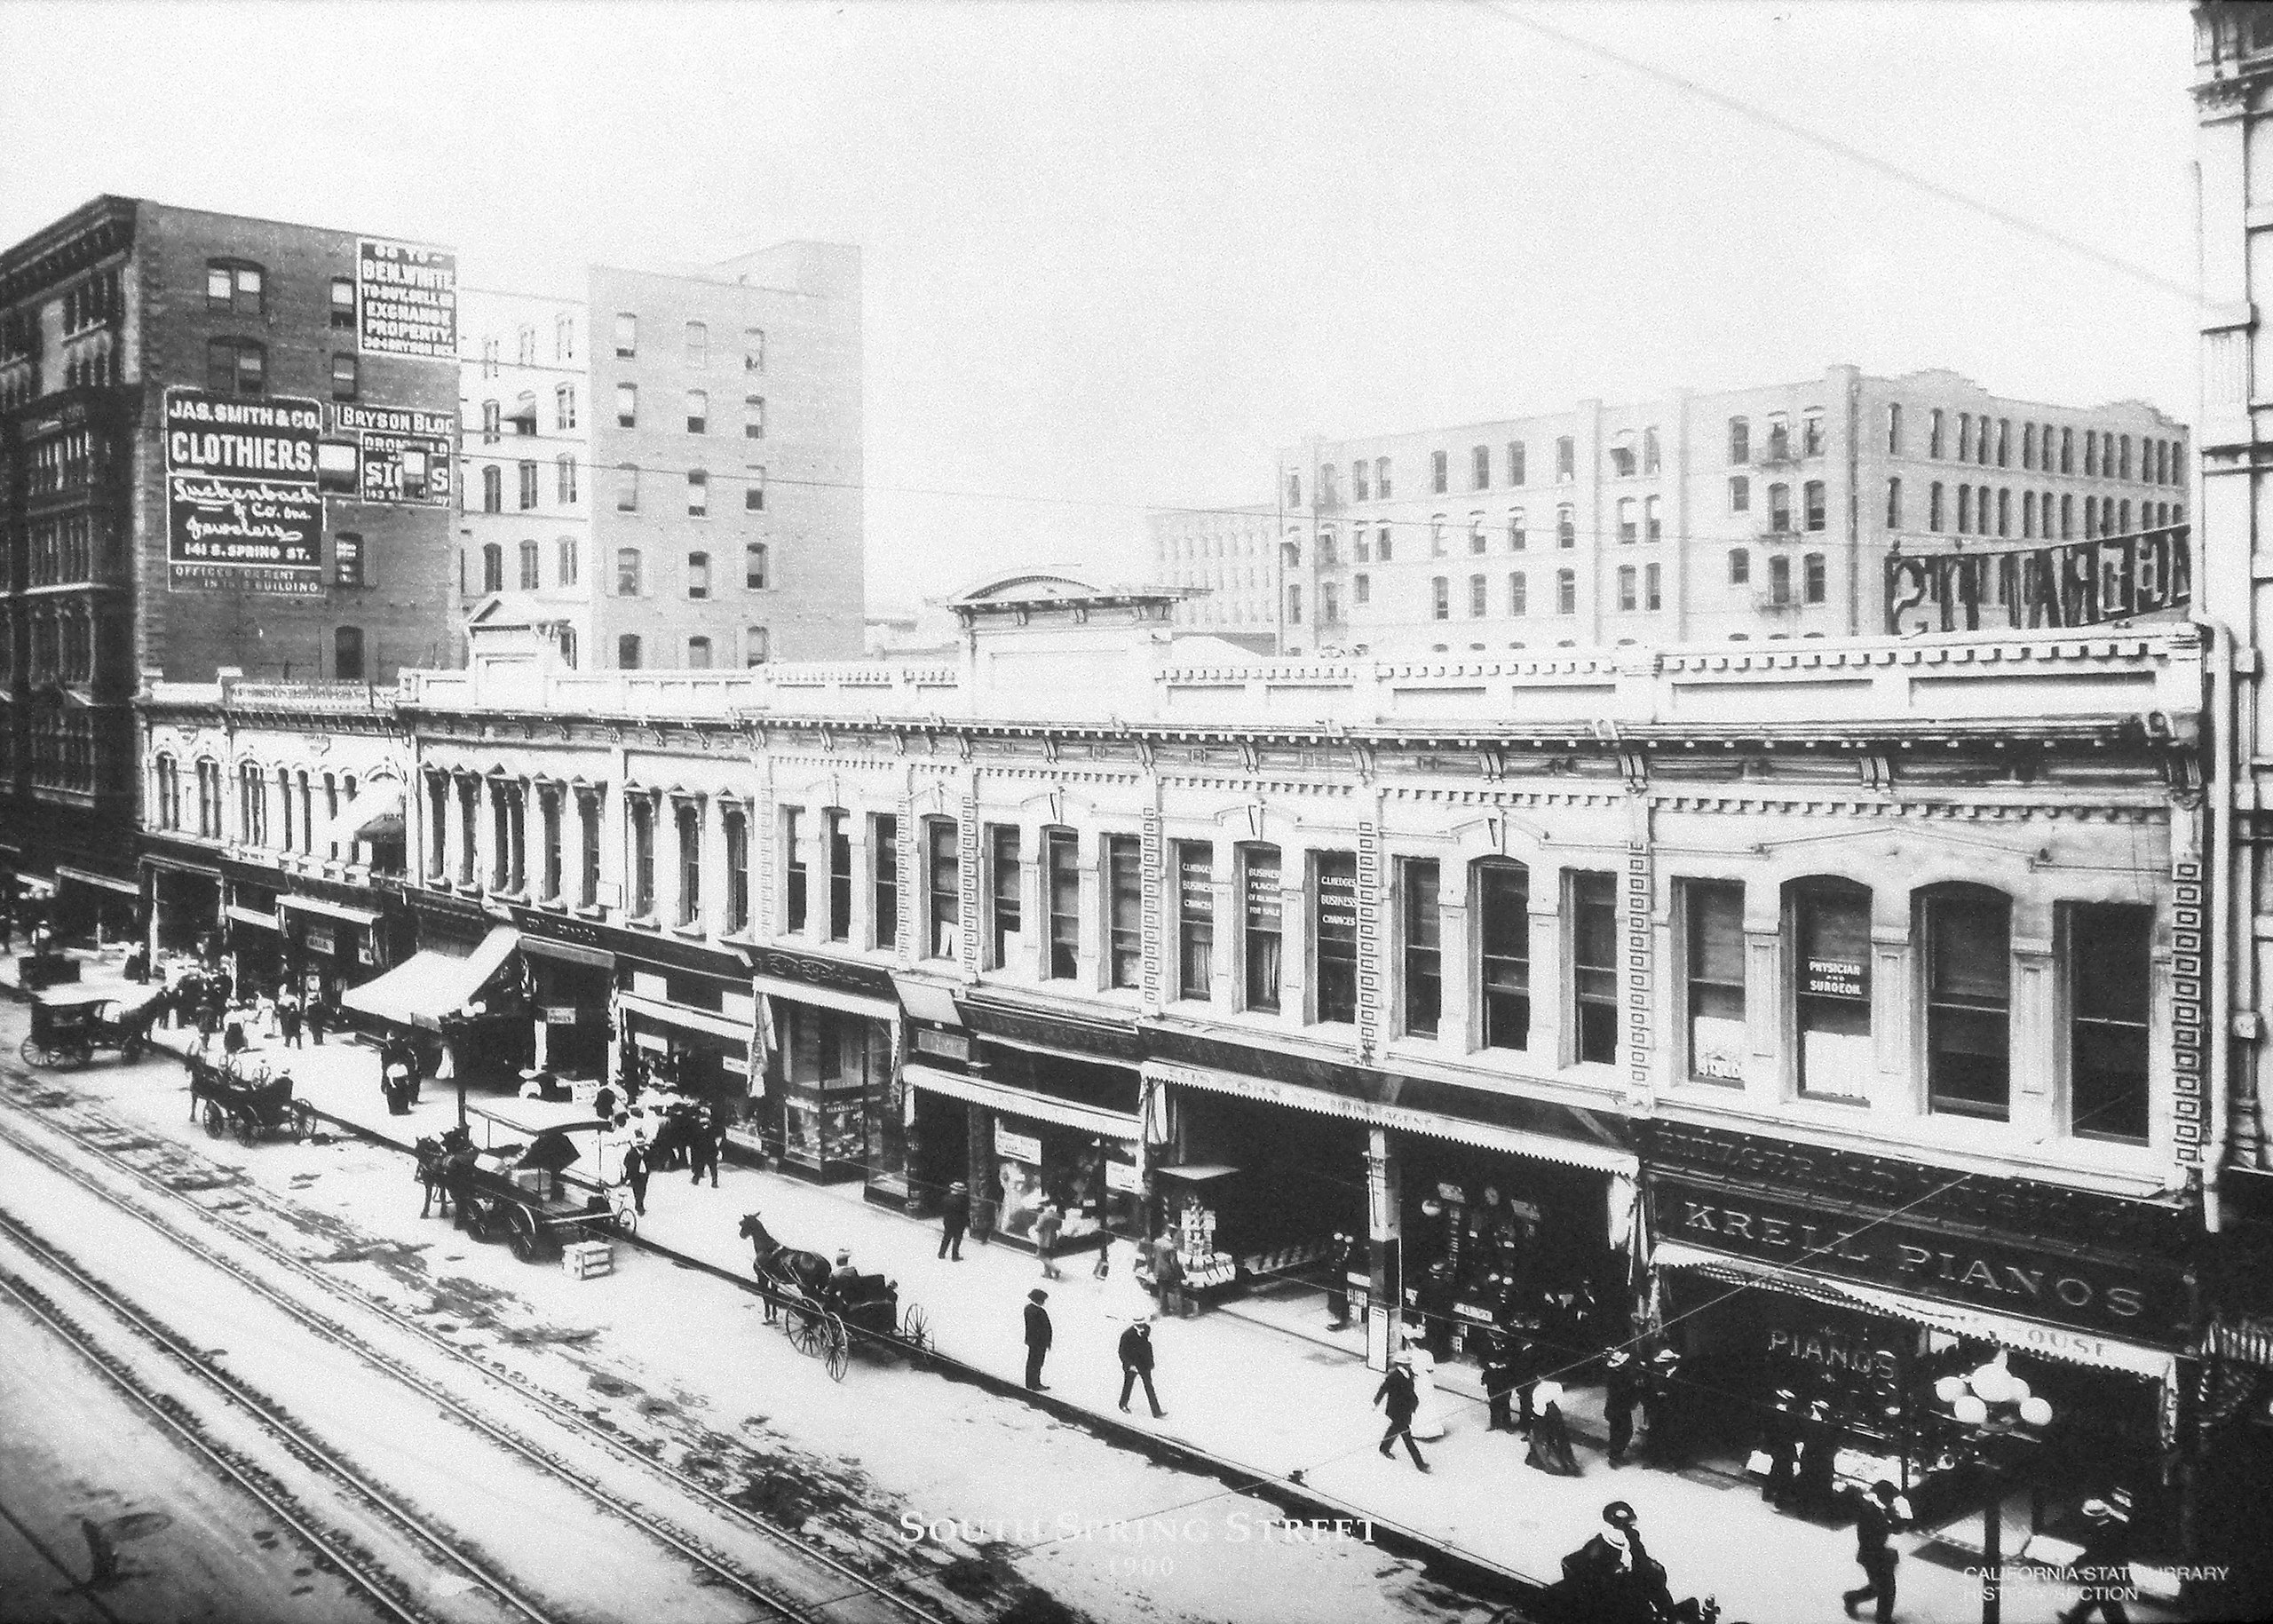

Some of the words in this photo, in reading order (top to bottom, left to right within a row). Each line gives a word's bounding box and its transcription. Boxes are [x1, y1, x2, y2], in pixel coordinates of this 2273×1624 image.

[170, 400, 214, 422] JAS.
[214, 403, 273, 427] SMITH
[275, 408, 289, 427] &
[227, 544, 281, 559] SPRING
[256, 582, 319, 594] BUILDING
[1322, 914, 1356, 927] CHANCES
[1809, 960, 1862, 976] PHYSICIAN
[1684, 1201, 1872, 1263] KRELL
[1897, 1243, 2144, 1318] PIANOS
[1768, 1329, 1897, 1380] PIANOS
